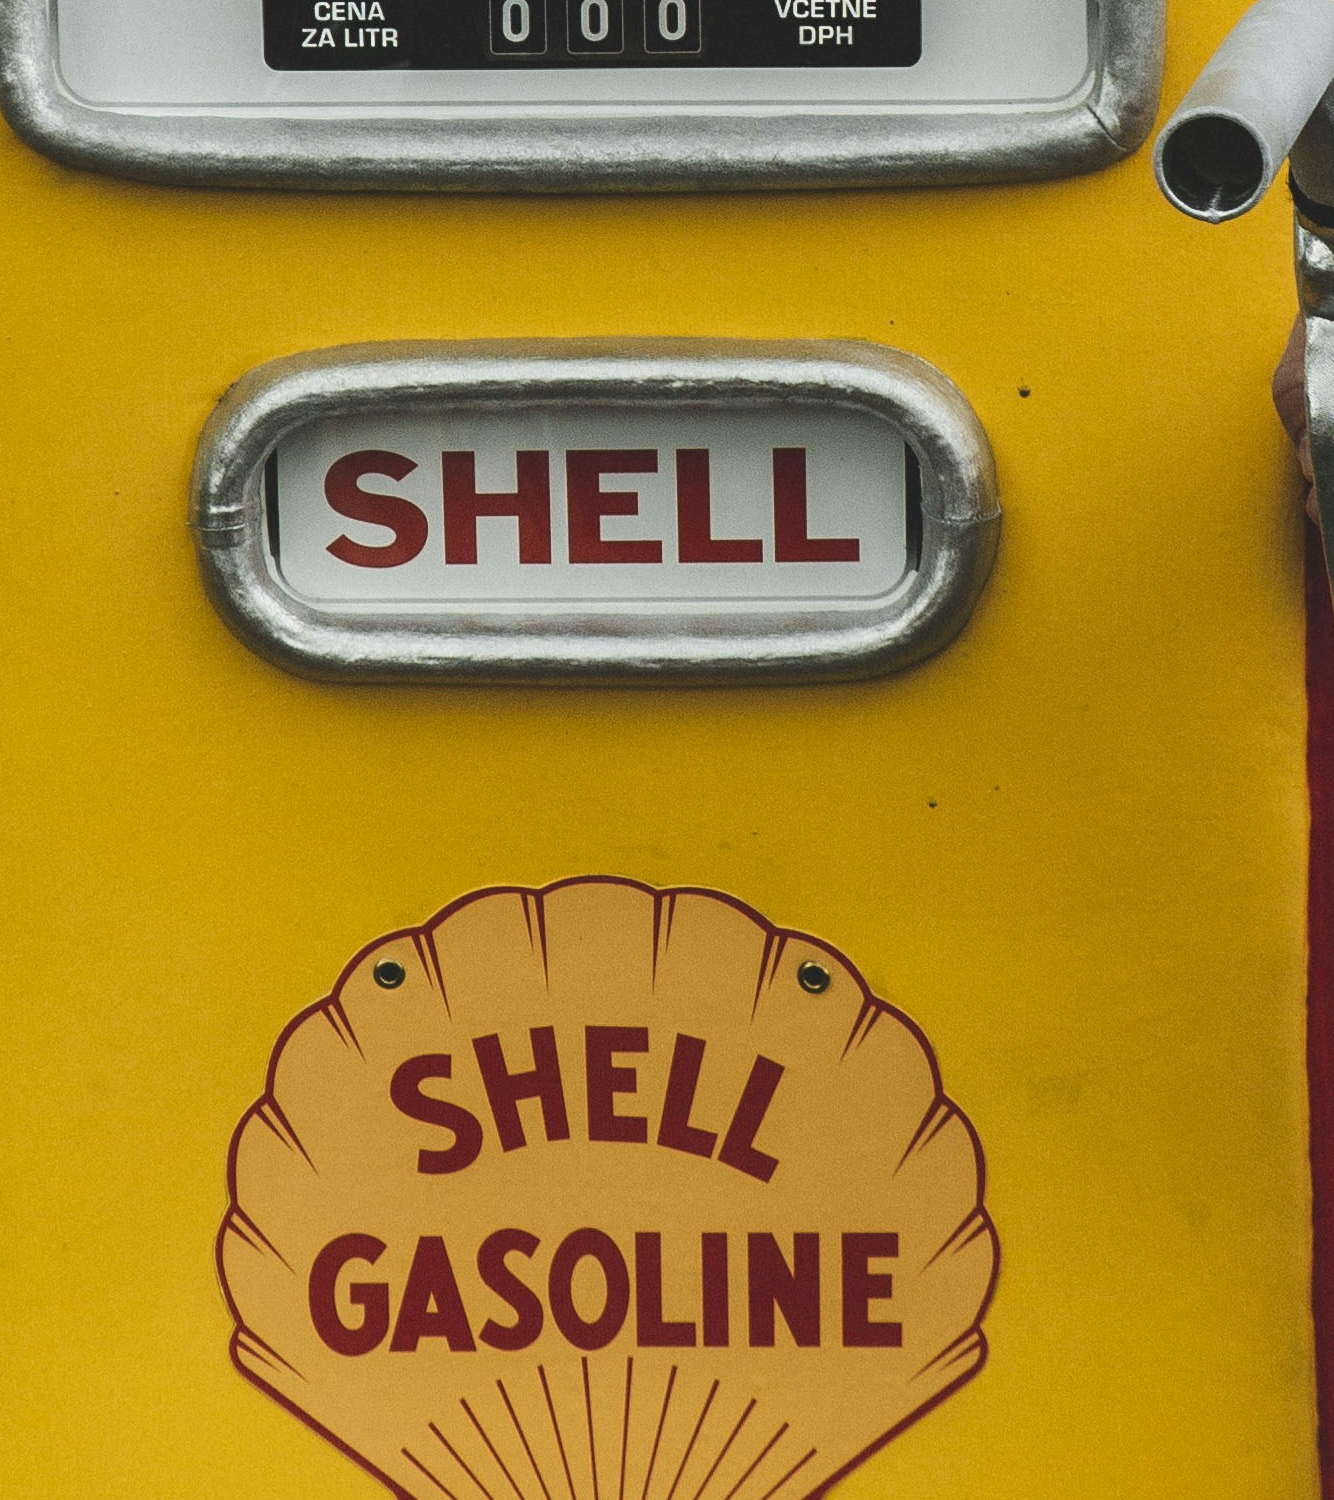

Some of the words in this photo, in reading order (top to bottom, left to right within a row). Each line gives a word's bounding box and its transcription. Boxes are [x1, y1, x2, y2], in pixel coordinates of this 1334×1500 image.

[301, 27, 336, 48] ZA
[344, 27, 399, 48] LITR
[313, 1, 386, 22] CENA
[798, 25, 854, 46] DPH
[323, 446, 861, 569] SHELL
[388, 1024, 786, 1184] SHELL
[307, 1226, 903, 1357] GASOLINE
